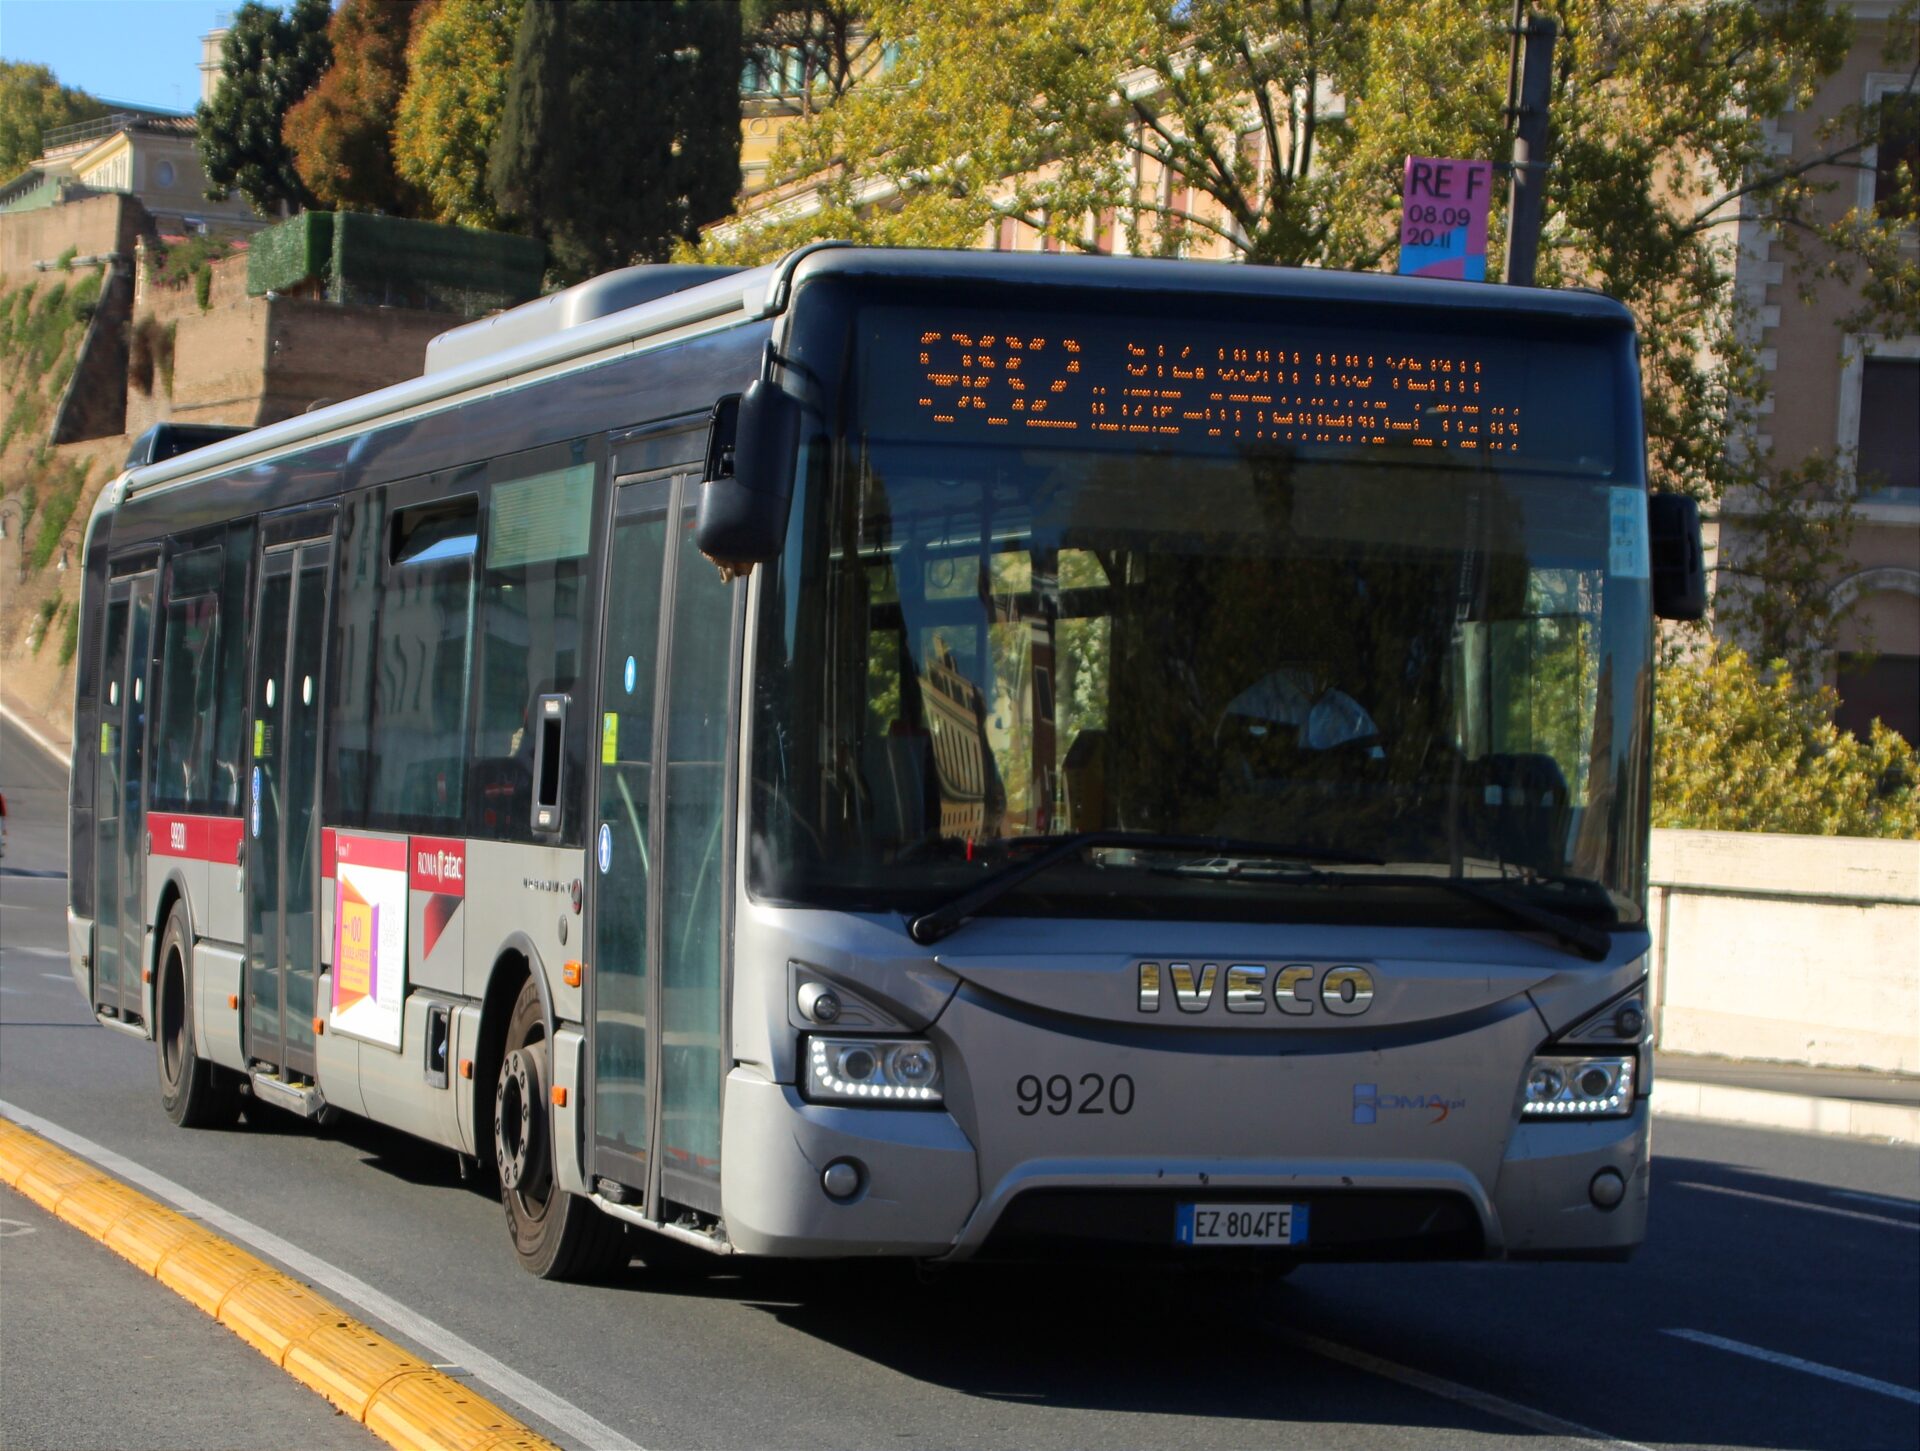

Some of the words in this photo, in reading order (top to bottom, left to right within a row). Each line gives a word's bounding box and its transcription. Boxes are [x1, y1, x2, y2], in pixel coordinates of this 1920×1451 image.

[1408, 204, 1471, 226] 08.09
[170, 822, 187, 851] 9920
[417, 851, 437, 876] ROMA
[444, 852, 463, 880] atac
[1137, 961, 1375, 1018] IVECO
[1016, 1072, 1136, 1117] 9920
[1195, 1211, 1220, 1238] EZ
[1226, 1211, 1291, 1238] 804FE
